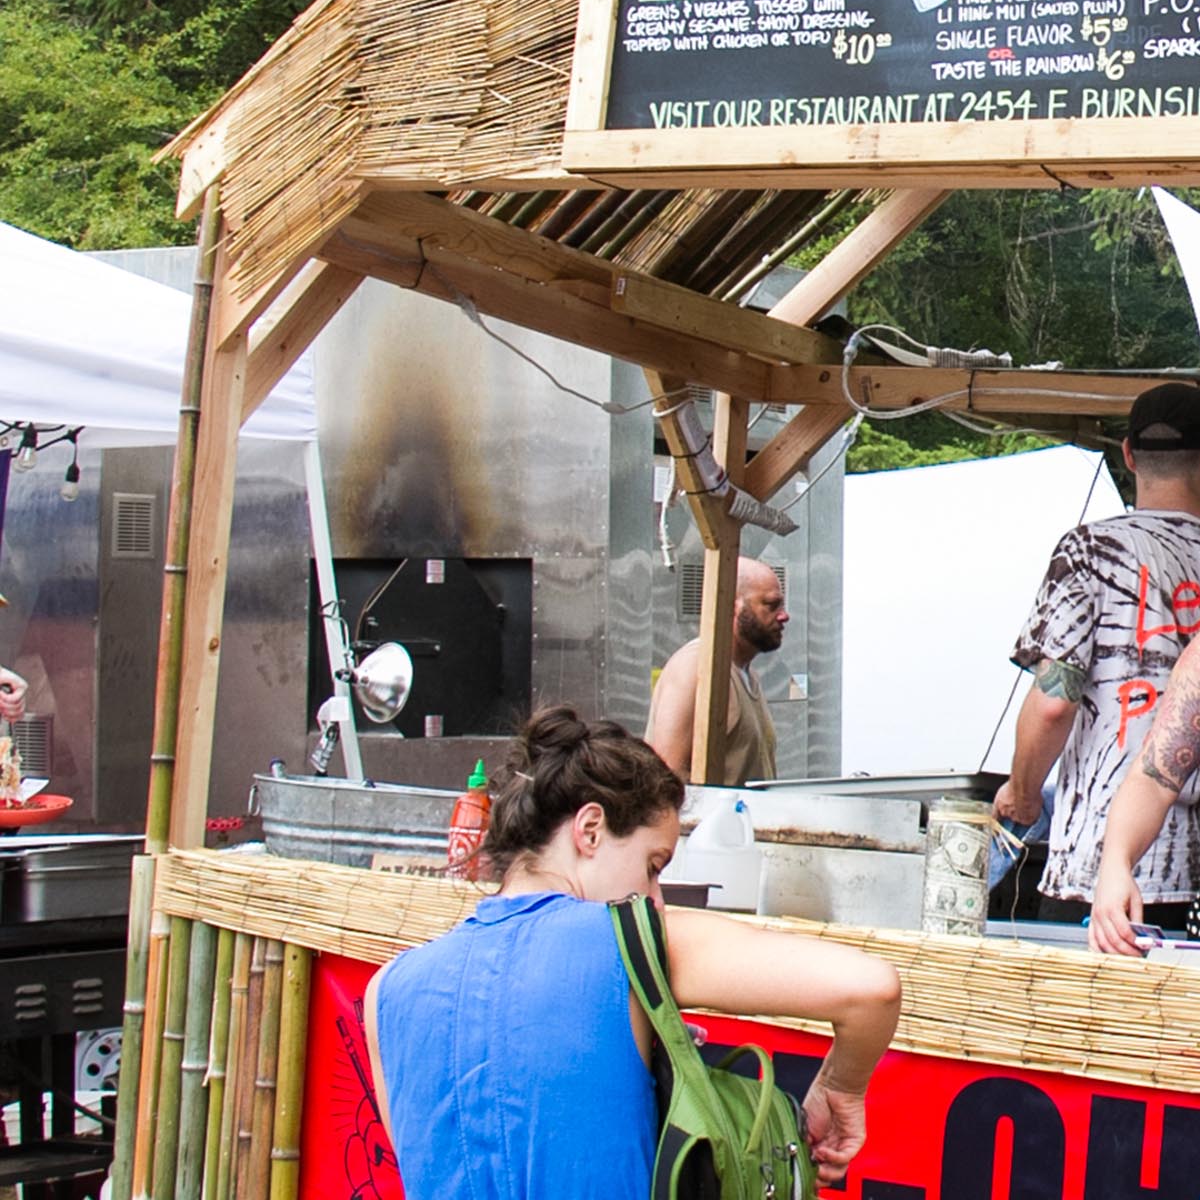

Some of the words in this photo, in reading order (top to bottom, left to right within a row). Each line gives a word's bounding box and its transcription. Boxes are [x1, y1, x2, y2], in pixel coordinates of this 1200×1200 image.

[626, 4, 680, 22] GREENS
[626, 20, 686, 36] CREAMY
[803, 10, 874, 29] DRESSING
[938, 7, 952, 24] LI
[958, 4, 990, 22] HING
[996, 4, 1026, 20] MUI
[623, 36, 671, 52] TOPPED
[674, 34, 709, 50] WITH
[713, 33, 768, 49] CHICKEN
[771, 32, 791, 46] OR
[792, 31, 831, 45] TOFU
[936, 27, 996, 50] SINGLE
[1007, 23, 1074, 47] FLAVOR
[988, 48, 1016, 60] OR
[932, 60, 986, 80] TASTE
[991, 58, 1022, 76] THE
[1025, 54, 1094, 76] RAINBOW
[649, 101, 709, 129] VISIT
[713, 100, 761, 127] OUR
[769, 93, 919, 127] RESTAURANT
[924, 93, 954, 123] AT
[959, 90, 1037, 123] 2454
